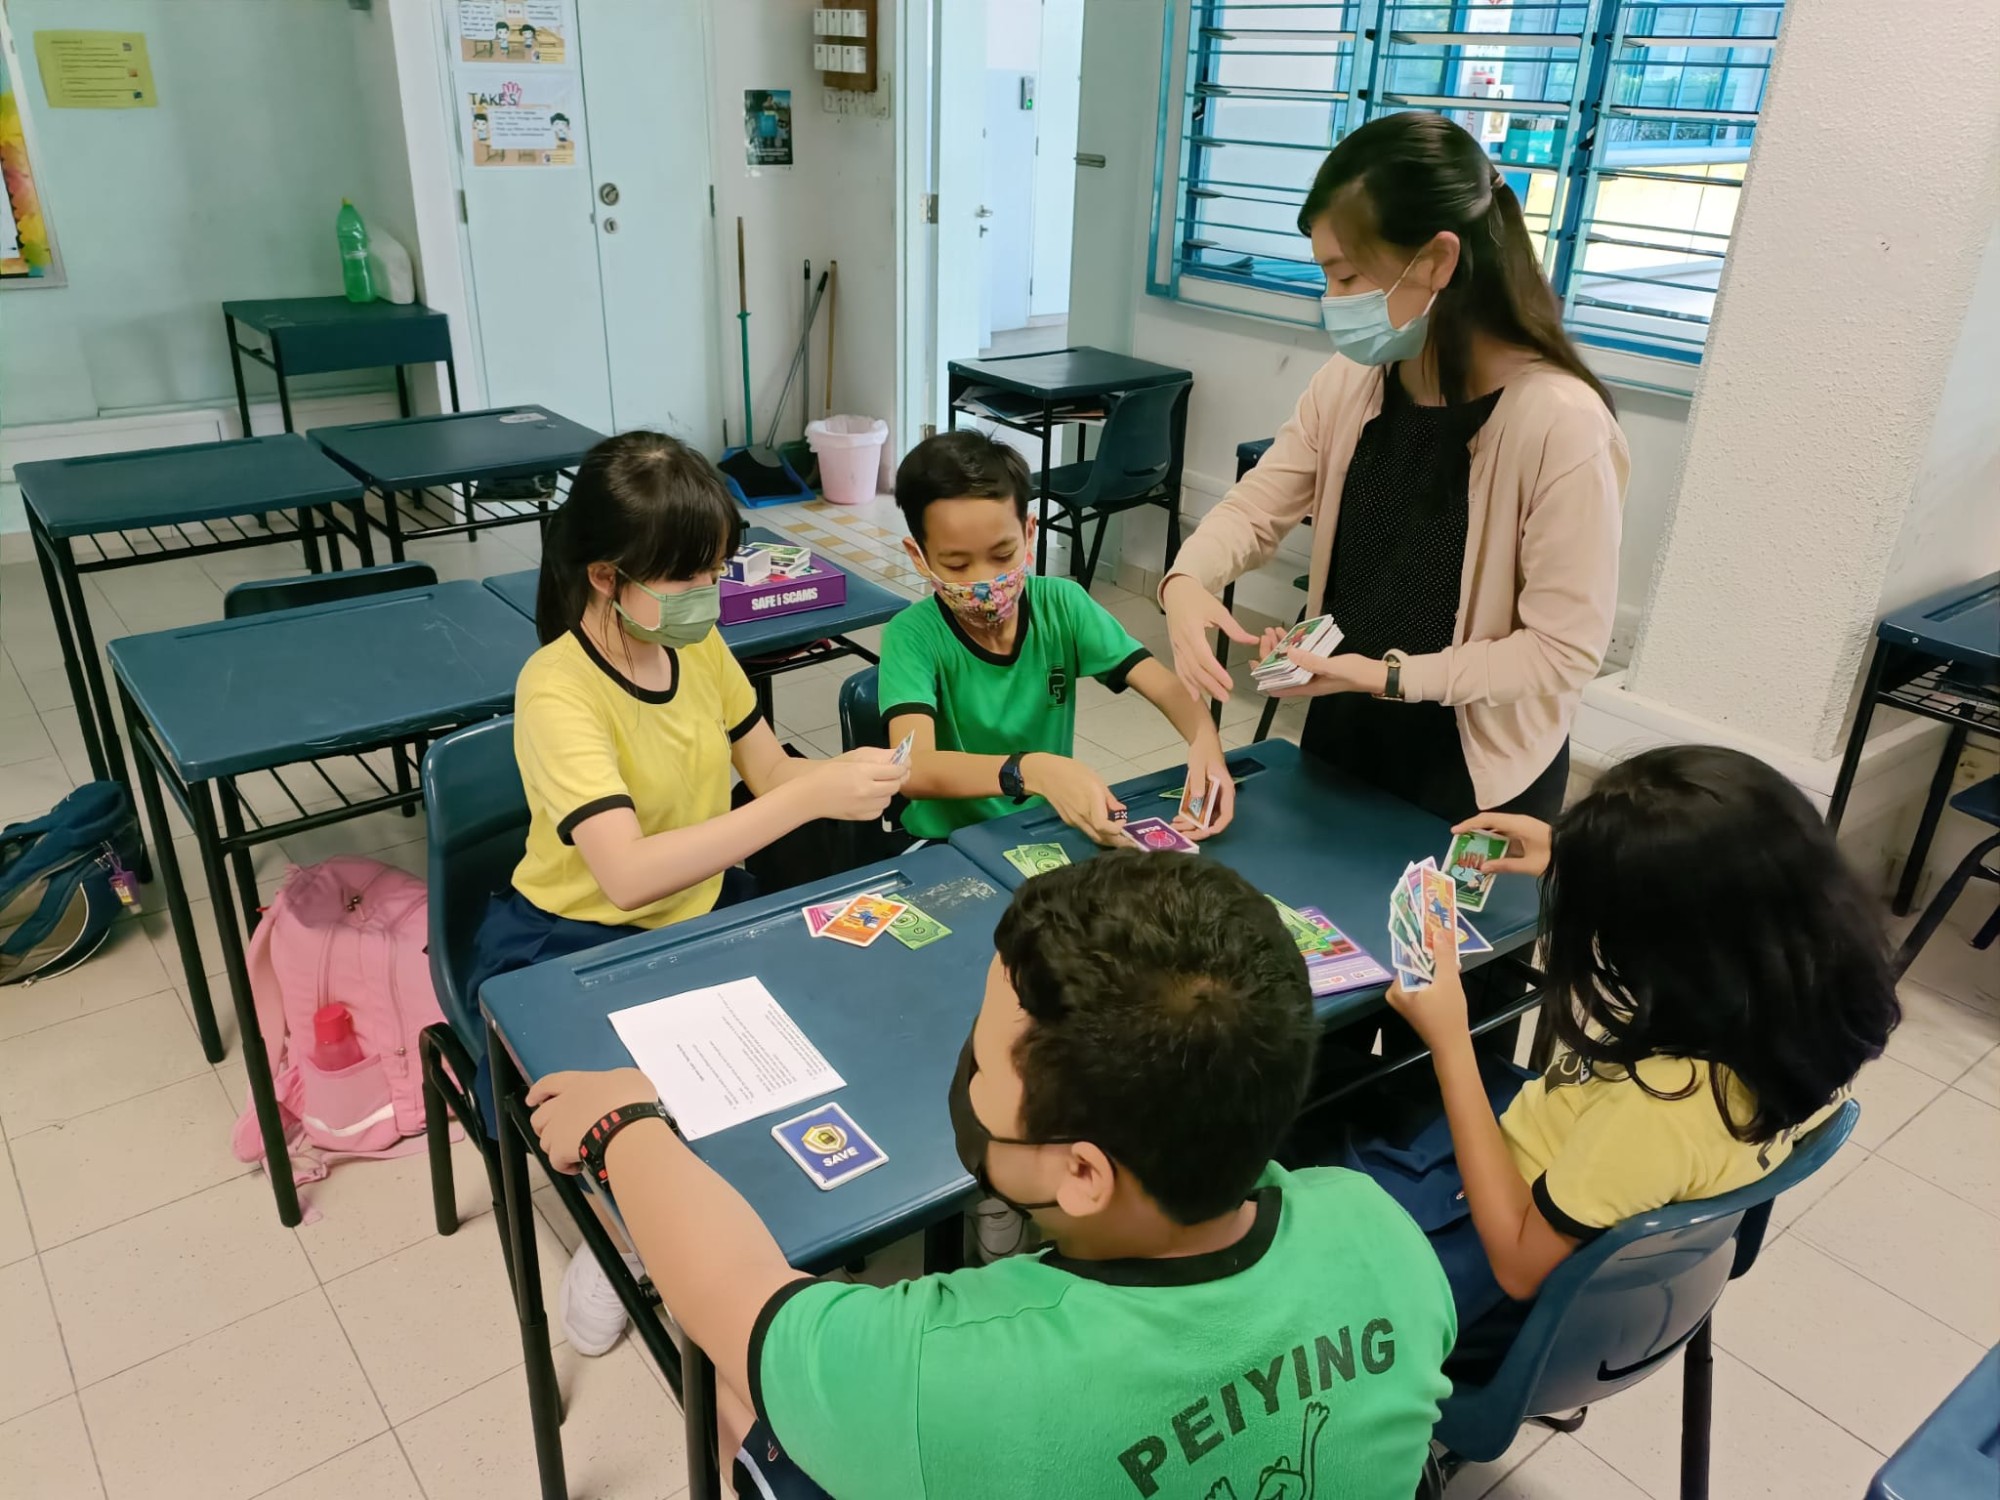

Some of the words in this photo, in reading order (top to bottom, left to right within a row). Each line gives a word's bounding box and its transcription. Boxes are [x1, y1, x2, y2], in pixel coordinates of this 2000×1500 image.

[751, 594, 776, 611] SAFE
[782, 587, 818, 605] SCAMS
[822, 1146, 860, 1168] SAVE
[1117, 1317, 1396, 1500] PEIYING
